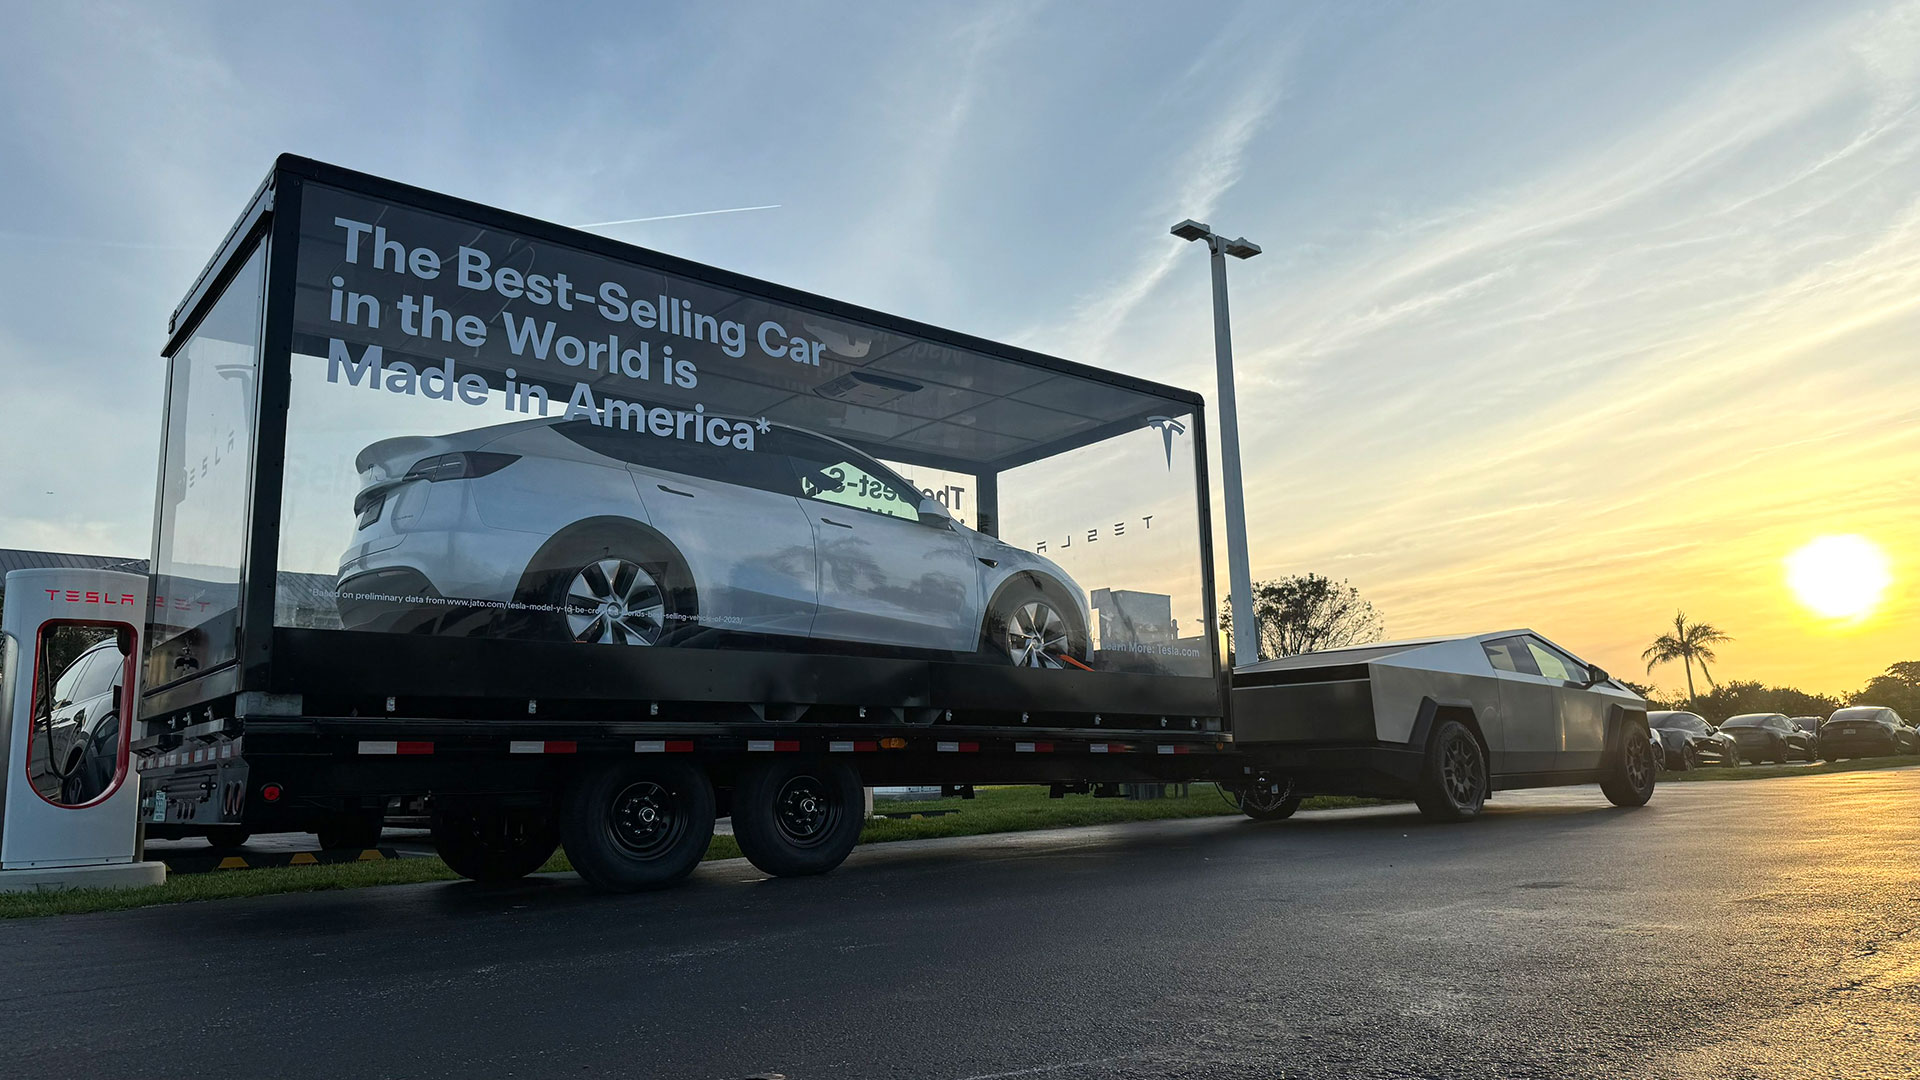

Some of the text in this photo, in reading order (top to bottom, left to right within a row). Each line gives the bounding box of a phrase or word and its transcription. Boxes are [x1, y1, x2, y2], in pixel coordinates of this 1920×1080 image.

[334, 216, 441, 280] The
[457, 245, 746, 359] Best-Selling
[757, 320, 827, 367] Car
[330, 275, 698, 389] in the World is
[327, 338, 489, 406] Made
[505, 368, 548, 416] in
[44, 588, 135, 606] TESLA
[342, 592, 354, 600] on
[355, 592, 404, 604] preliminary
[405, 594, 424, 604] data
[425, 595, 446, 605] from
[1128, 642, 1156, 655] More:
[1156, 644, 1201, 658] Tesla.com
